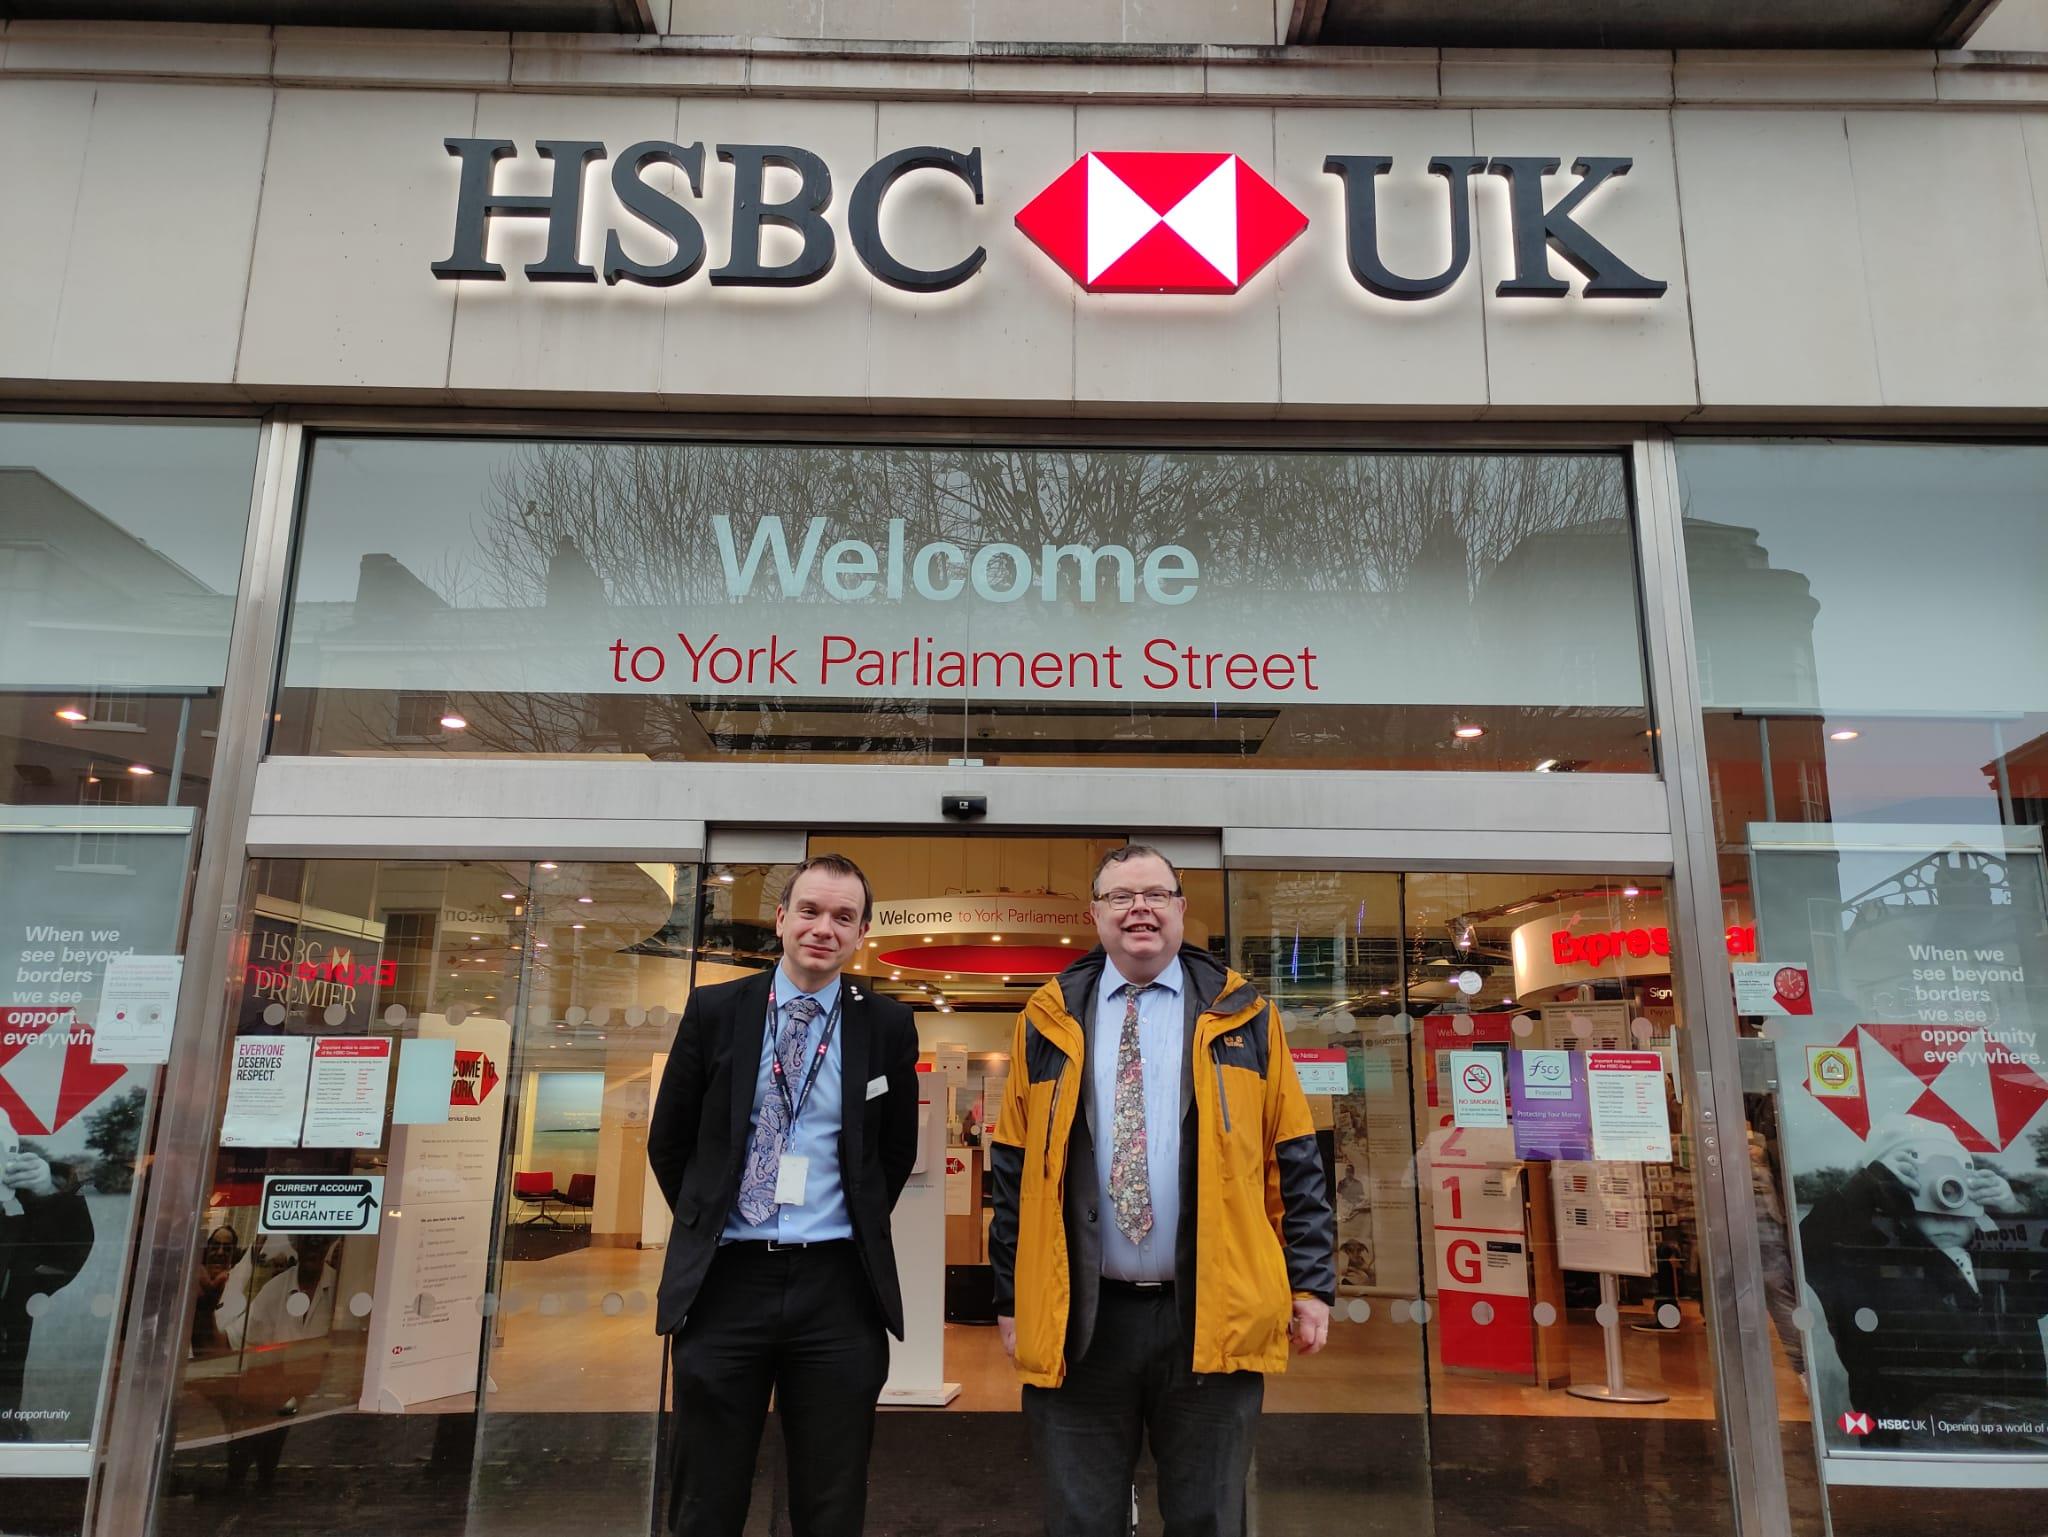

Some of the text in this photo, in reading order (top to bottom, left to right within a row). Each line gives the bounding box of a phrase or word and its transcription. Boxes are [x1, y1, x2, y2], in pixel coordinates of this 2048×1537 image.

[430, 138, 1668, 301] HSBC UK
[713, 514, 1199, 604] Welcome
[609, 632, 1319, 692] to York Parliament Street
[879, 910, 953, 925] Welcome
[959, 911, 971, 922] to
[974, 909, 1003, 923] York
[1008, 909, 1079, 925] Parliament
[25, 926, 120, 942] When we
[21, 949, 55, 962] see
[258, 931, 322, 968] HSBC
[1552, 928, 1670, 968] Expres
[1908, 945, 2005, 961] When we
[16, 967, 93, 983] borders
[1912, 965, 2024, 984] see beyond
[12, 991, 82, 1003] we see
[252, 969, 356, 1015] PREMIER
[1915, 985, 1991, 1001] borders
[1918, 1009, 1987, 1022] we see
[3, 1029, 96, 1049] everywh
[1921, 1027, 2037, 1047] opportunity
[240, 1044, 285, 1056] EVERYONE
[1923, 1048, 2046, 1067] everywhere.
[238, 1057, 282, 1069] DESERVES
[1517, 1110, 1546, 1118] Protecting
[1562, 1111, 1581, 1119] Money
[275, 1184, 363, 1192] CURRENT ACCOUNT
[273, 1200, 316, 1209] SWITCH
[1442, 1176, 1462, 1219] 1
[271, 1210, 354, 1221] GUARANTEE
[1446, 1239, 1482, 1284] G
[2, 1408, 71, 1421] of opportunity
[1878, 1419, 2045, 1434] HSBC UK Opening up a world of
